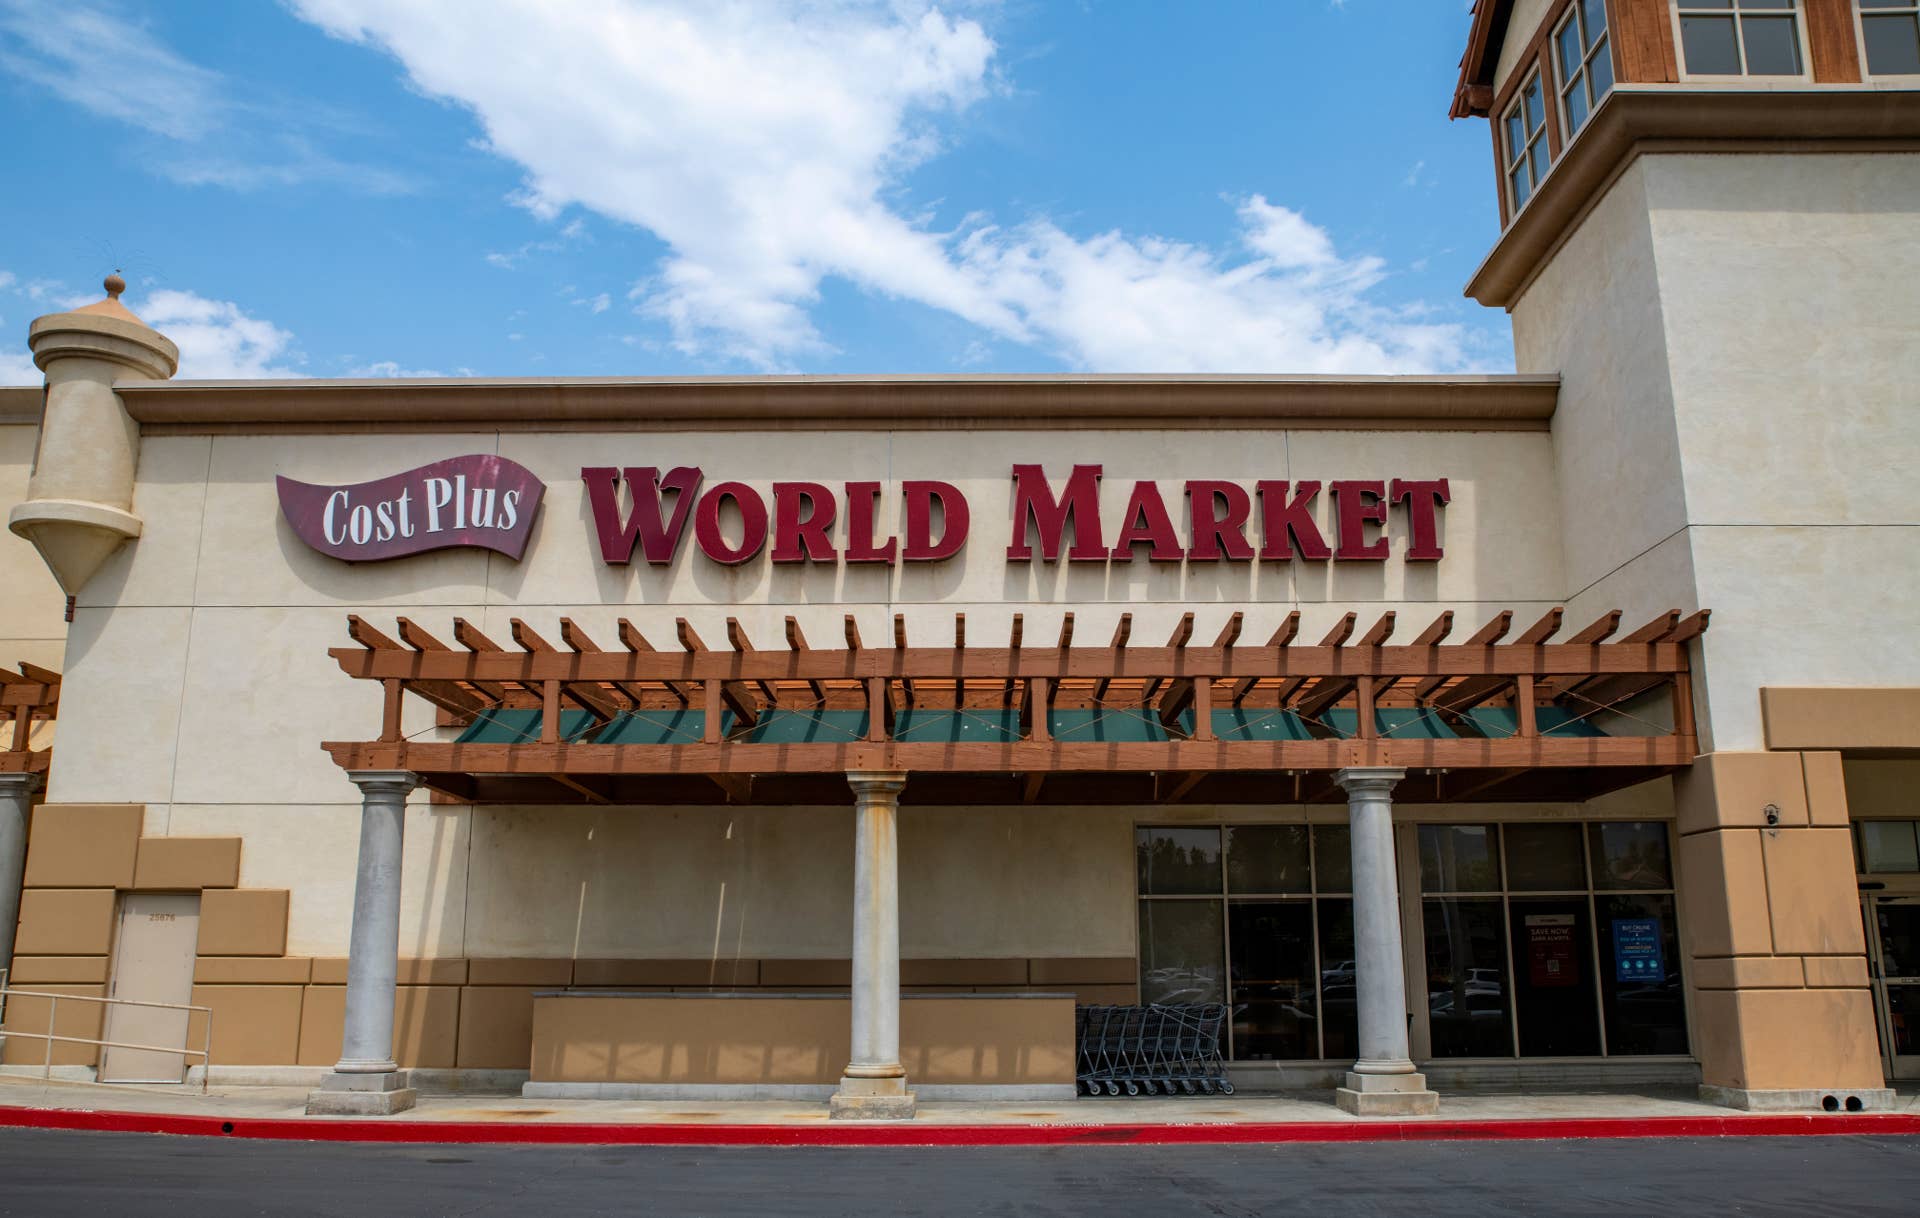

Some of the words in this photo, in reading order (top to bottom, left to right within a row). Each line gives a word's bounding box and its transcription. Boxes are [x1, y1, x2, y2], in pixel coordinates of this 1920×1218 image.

[322, 486, 415, 546] Cost
[424, 474, 521, 533] Plus
[581, 466, 971, 567] WORLD
[1007, 464, 1452, 563] MARKET
